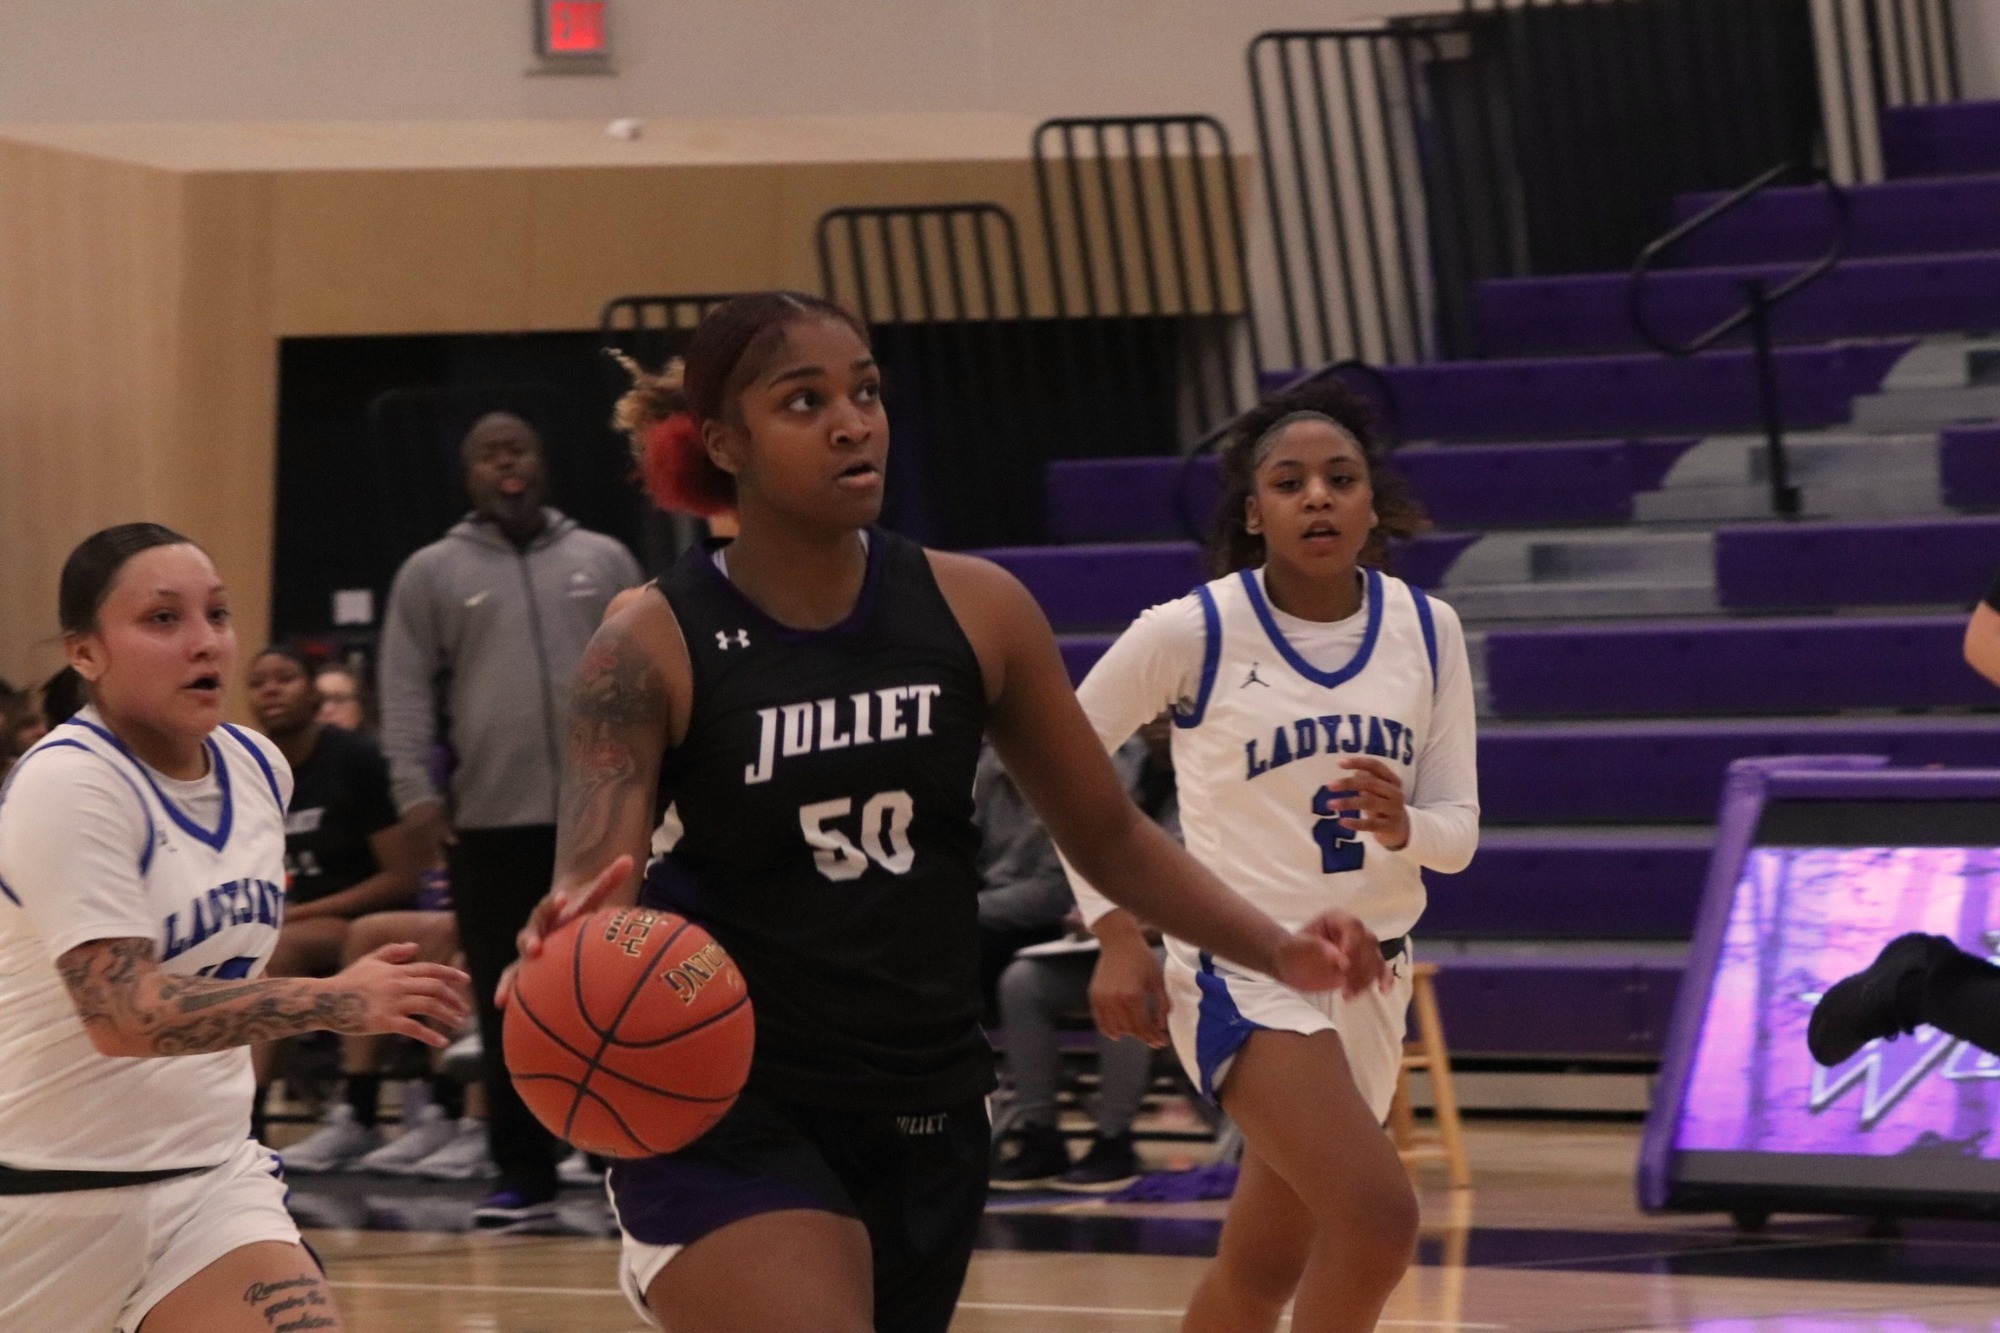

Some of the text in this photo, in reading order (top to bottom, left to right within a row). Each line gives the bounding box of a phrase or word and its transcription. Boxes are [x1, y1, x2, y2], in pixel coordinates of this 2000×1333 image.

[744, 684, 942, 785] JOLIET
[1245, 714, 1415, 781] LADYJAYS
[799, 790, 916, 882] 50
[1311, 785, 1364, 873] 2
[622, 910, 659, 956] ACY
[662, 941, 726, 1005] DING
